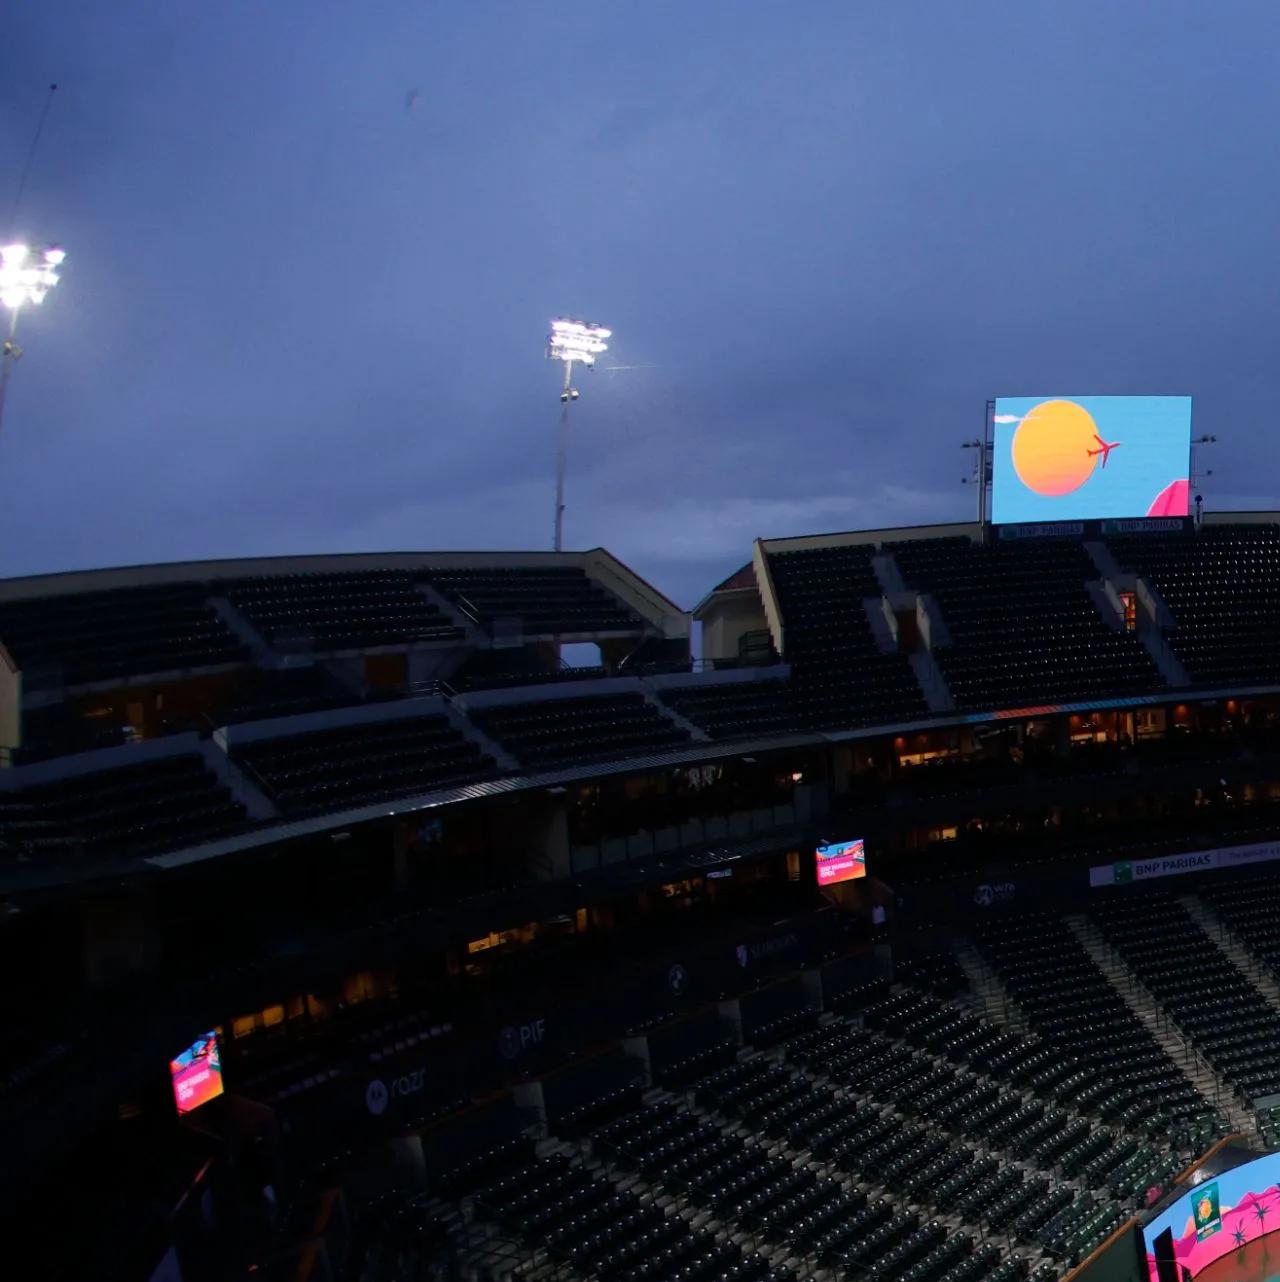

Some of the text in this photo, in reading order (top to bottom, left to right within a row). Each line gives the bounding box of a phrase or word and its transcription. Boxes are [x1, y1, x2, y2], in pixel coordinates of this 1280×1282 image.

[1135, 854, 1211, 876] BNP PARIBAS
[520, 1018, 546, 1050] PIF
